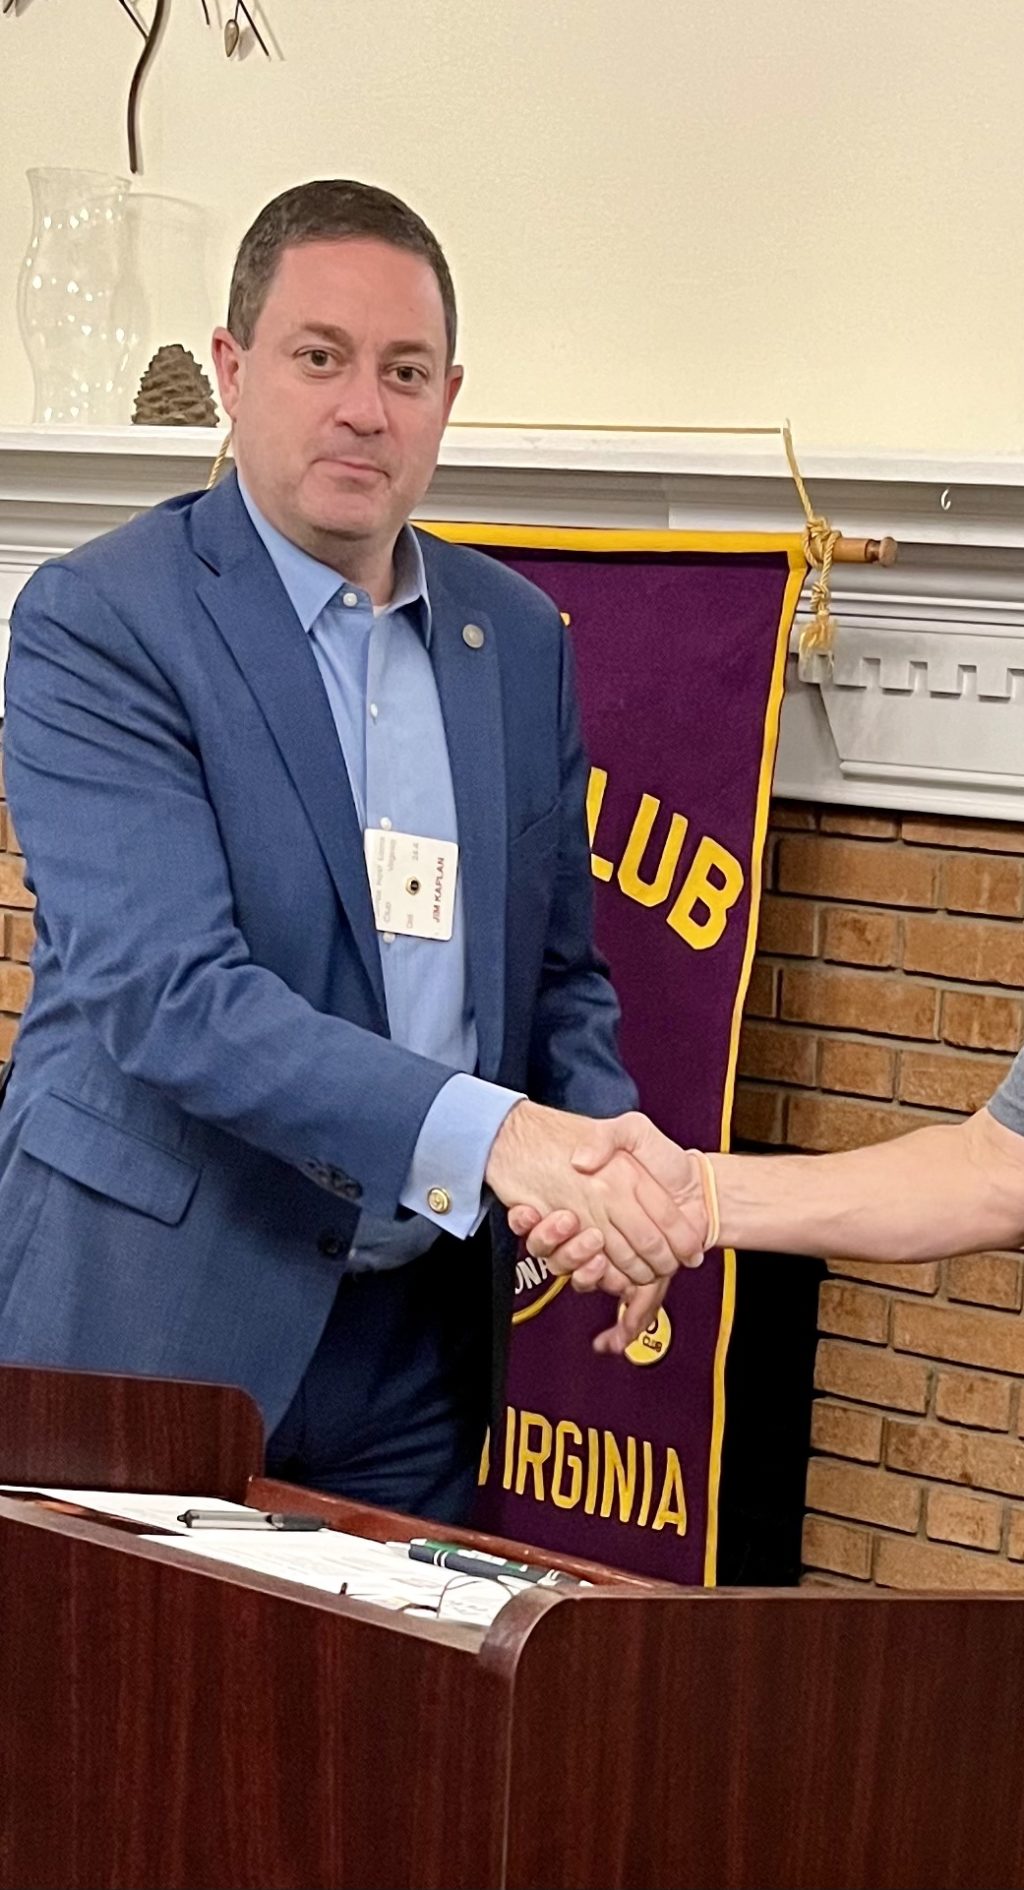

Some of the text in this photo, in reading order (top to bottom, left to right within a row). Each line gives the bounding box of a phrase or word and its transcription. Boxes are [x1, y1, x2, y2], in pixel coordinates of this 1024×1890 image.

[432, 857, 445, 923] JIM KAPLAN
[586, 766, 744, 950] LUB
